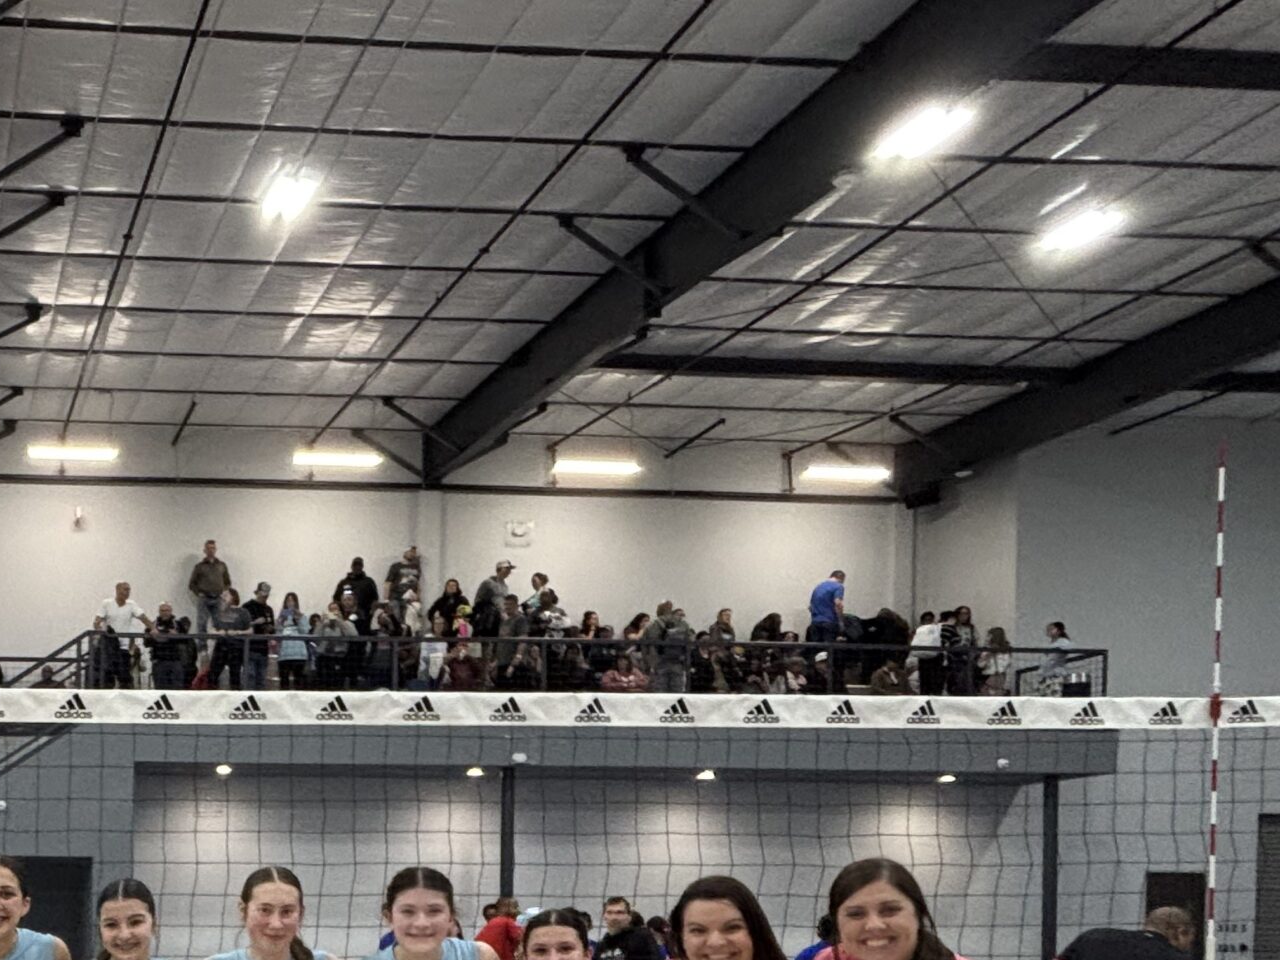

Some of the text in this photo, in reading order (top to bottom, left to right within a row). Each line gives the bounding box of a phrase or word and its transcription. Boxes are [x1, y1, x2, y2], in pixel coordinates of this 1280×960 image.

[54, 709, 93, 719] adidas
[142, 710, 180, 720] adidas
[229, 711, 266, 721] adidas
[316, 711, 354, 721] adidas
[402, 712, 440, 722] adidas
[489, 713, 527, 723] adidas
[575, 713, 611, 723] adidas
[659, 714, 695, 724] adidas
[743, 715, 780, 724] adidas
[826, 715, 860, 725] adidas
[906, 715, 941, 725] adidas
[986, 716, 1022, 726] adidas
[1069, 716, 1105, 726] adidas
[1148, 716, 1183, 726] adidas
